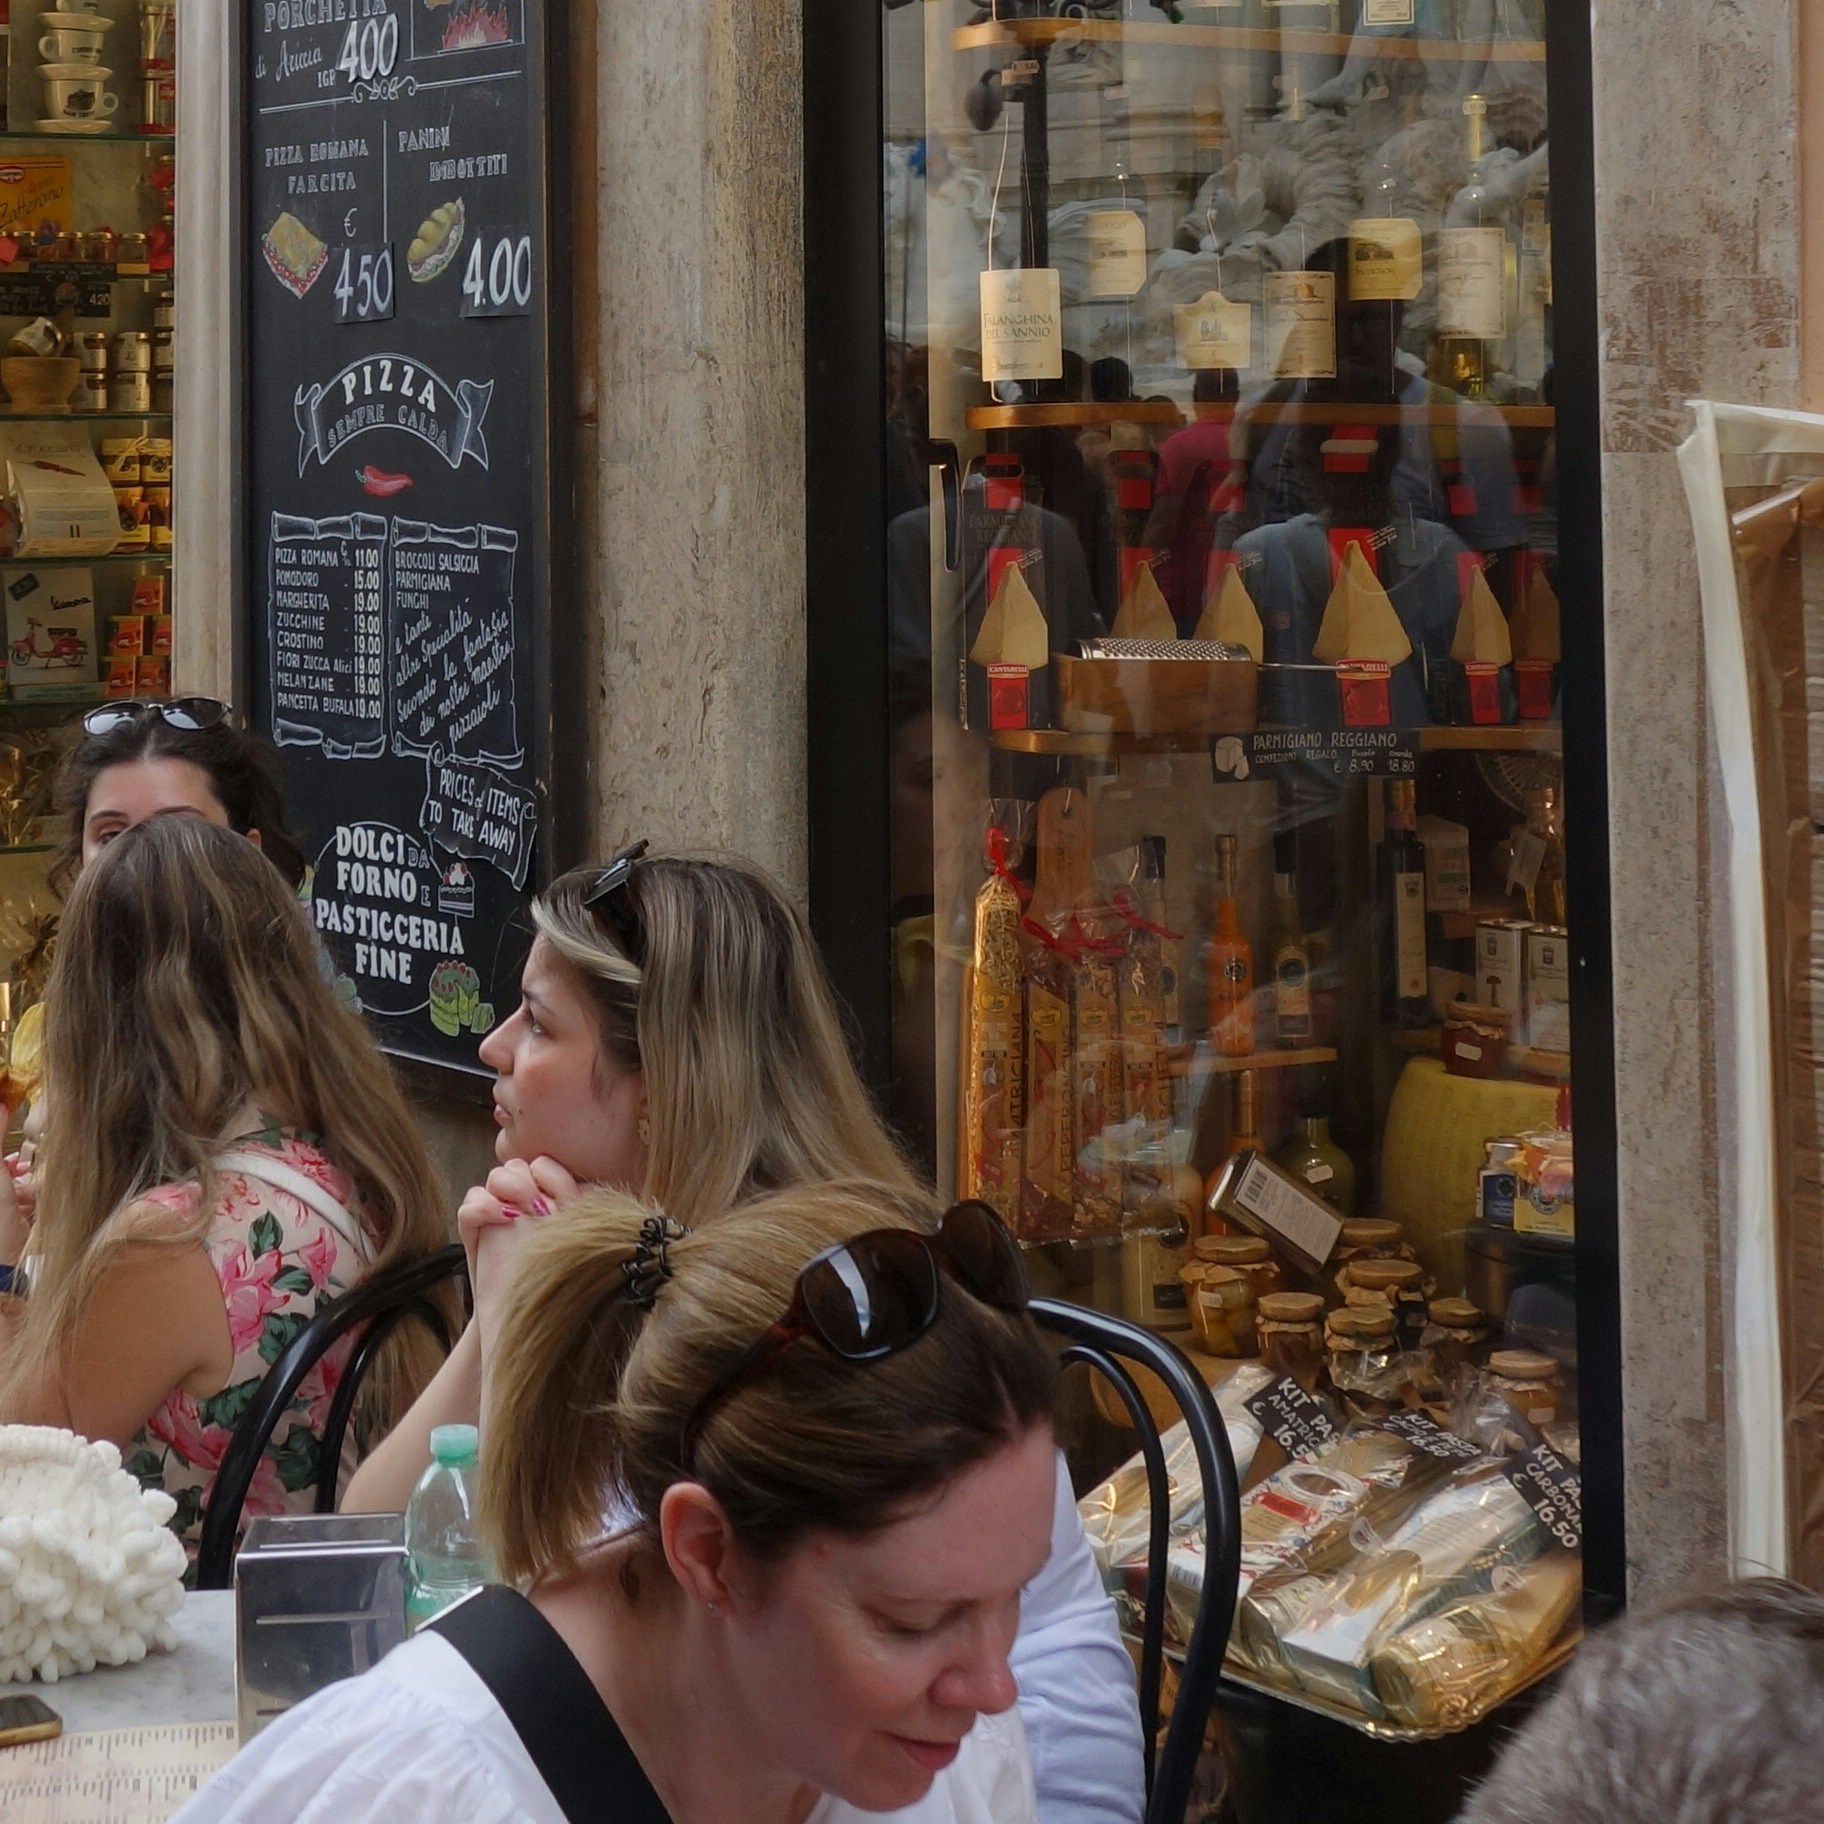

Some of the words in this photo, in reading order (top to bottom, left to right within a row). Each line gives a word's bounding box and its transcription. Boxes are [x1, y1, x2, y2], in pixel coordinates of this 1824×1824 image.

[317, 68, 336, 89] IGP
[398, 125, 450, 153] PANINI
[264, 146, 304, 167] PIZZA
[309, 138, 369, 162] ROMANA
[288, 171, 357, 195] FARCITA
[344, 207, 357, 237] €
[1003, 326, 1051, 339] SANNIO
[342, 360, 436, 412] PIZZA
[327, 404, 385, 450] SEMPRE
[397, 405, 448, 455] CALDA
[275, 547, 297, 564] PIZZA
[301, 549, 339, 567] ROMANA
[438, 553, 480, 574] SALSICCIA
[276, 570, 319, 587] POMODORO
[396, 571, 451, 592] PARMIGIANA
[276, 591, 329, 611] MARGHERITA
[396, 592, 429, 610] FUNGHI
[277, 612, 325, 631] ZUCCHINE
[277, 631, 324, 650] CROSTINO
[277, 653, 301, 670] FIORI
[303, 655, 330, 672] ZUCCA
[277, 671, 335, 692] MELANZANE
[277, 692, 319, 712] PANCETTA
[323, 696, 355, 716] BUFALA
[1253, 732, 1322, 751] PARMIGIANO
[1331, 732, 1397, 748] REGGIANO
[439, 768, 476, 806] PRICES
[486, 787, 521, 825] ITEMS
[428, 799, 443, 824] TO
[451, 806, 475, 839] TAKE
[478, 821, 516, 856] AWAY
[336, 826, 406, 866] DOLCI
[408, 846, 431, 869] DA
[336, 861, 417, 904] FORNO
[420, 885, 431, 907] E
[315, 898, 465, 955] PASTICCERIA
[354, 942, 412, 985] FINE
[1278, 1377, 1310, 1408] KIT
[1251, 1402, 1264, 1416] €
[1405, 1414, 1439, 1430] KIT
[1531, 1443, 1563, 1472] KIT
[1512, 1473, 1527, 1489] €
